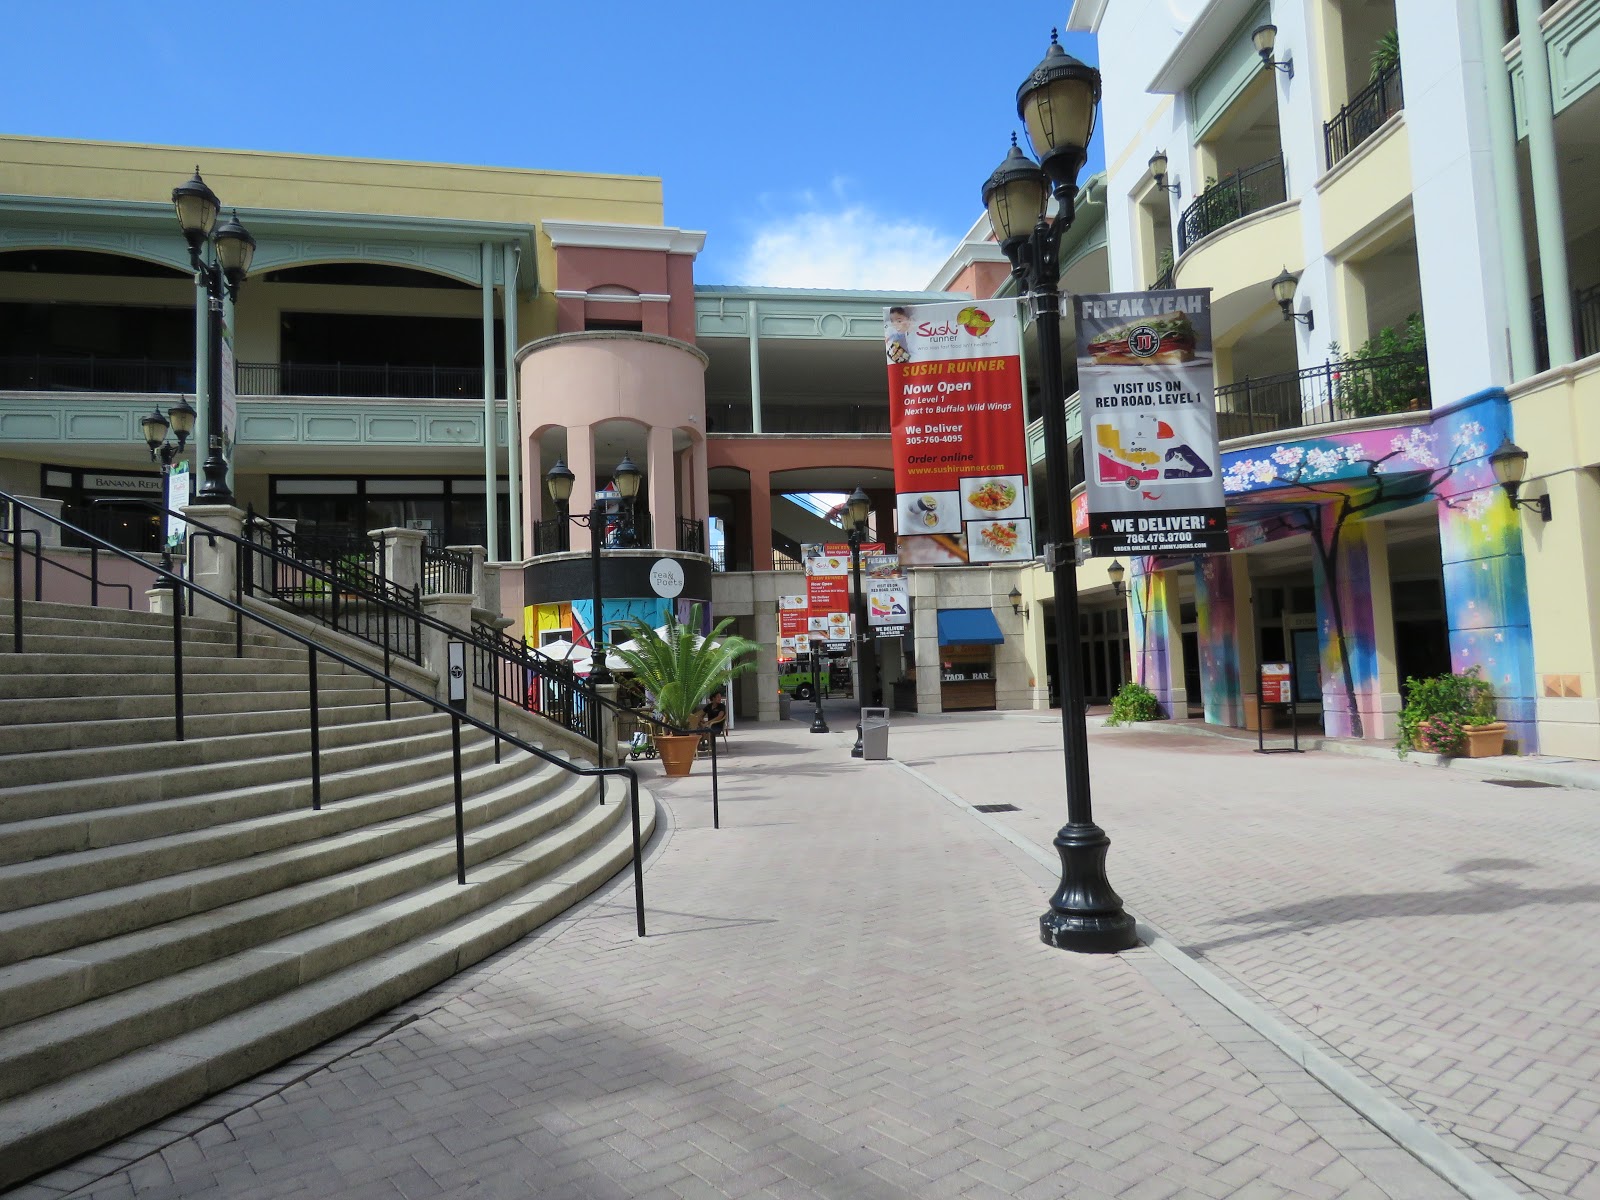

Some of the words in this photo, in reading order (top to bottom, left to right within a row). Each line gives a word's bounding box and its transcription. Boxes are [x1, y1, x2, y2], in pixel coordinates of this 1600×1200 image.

[1082, 299, 1145, 319] FREAK
[1150, 295, 1202, 316] YEAH
[916, 320, 959, 337] Sushi
[929, 335, 958, 343] runner
[902, 363, 943, 377] SUSHI
[947, 359, 1006, 374] RUNNER
[903, 383, 934, 395] Now
[937, 381, 972, 395] Open
[1113, 382, 1144, 395] VISIT
[1146, 381, 1162, 393] US
[1165, 380, 1182, 392] ON
[904, 398, 916, 406] On
[917, 396, 939, 405] Level
[941, 395, 945, 403] 1
[1095, 397, 1118, 408] RED
[1121, 394, 1156, 407] ROAD,
[1158, 392, 1193, 405] LEVEL
[1196, 392, 1201, 403] 1
[904, 408, 924, 416] Next
[925, 406, 934, 414] to
[936, 405, 965, 413] Buffalo
[967, 403, 985, 412] Wild
[987, 402, 1012, 412] Wings
[905, 425, 922, 435] We
[924, 424, 963, 434] Deliver
[905, 435, 963, 445] 305-760-4095
[907, 454, 938, 464] Order
[940, 453, 974, 463] online
[907, 463, 1005, 475] www.sushirunner.com
[96, 478, 136, 488] BANANA
[1111, 518, 1135, 533] WE
[1138, 515, 1206, 532] DELIVER!
[1125, 532, 1192, 544] 786.476.8700
[1158, 542, 1207, 551] JIMMYJOHNS.COM
